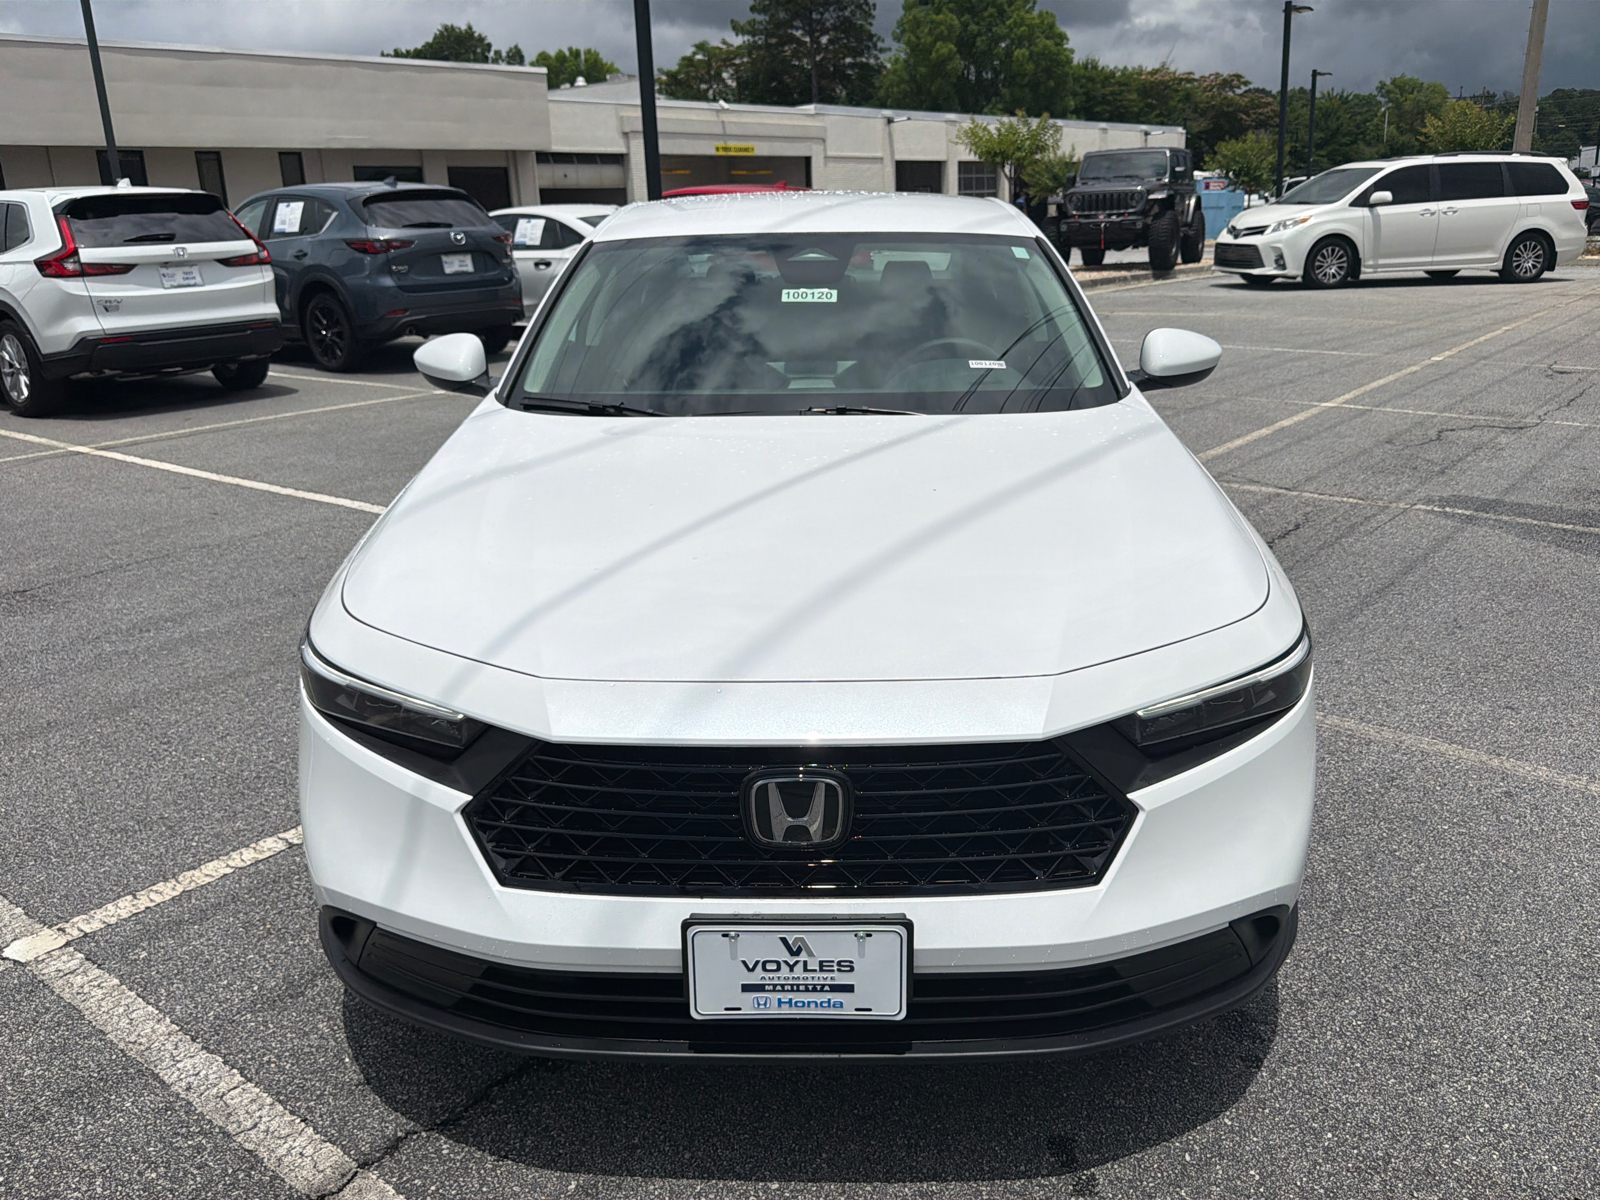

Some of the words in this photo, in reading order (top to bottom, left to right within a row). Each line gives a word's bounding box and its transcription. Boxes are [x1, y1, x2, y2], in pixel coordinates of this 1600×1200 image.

[784, 291, 833, 300] 100120
[741, 959, 855, 973] VOYLES
[777, 996, 844, 1009] Honda
